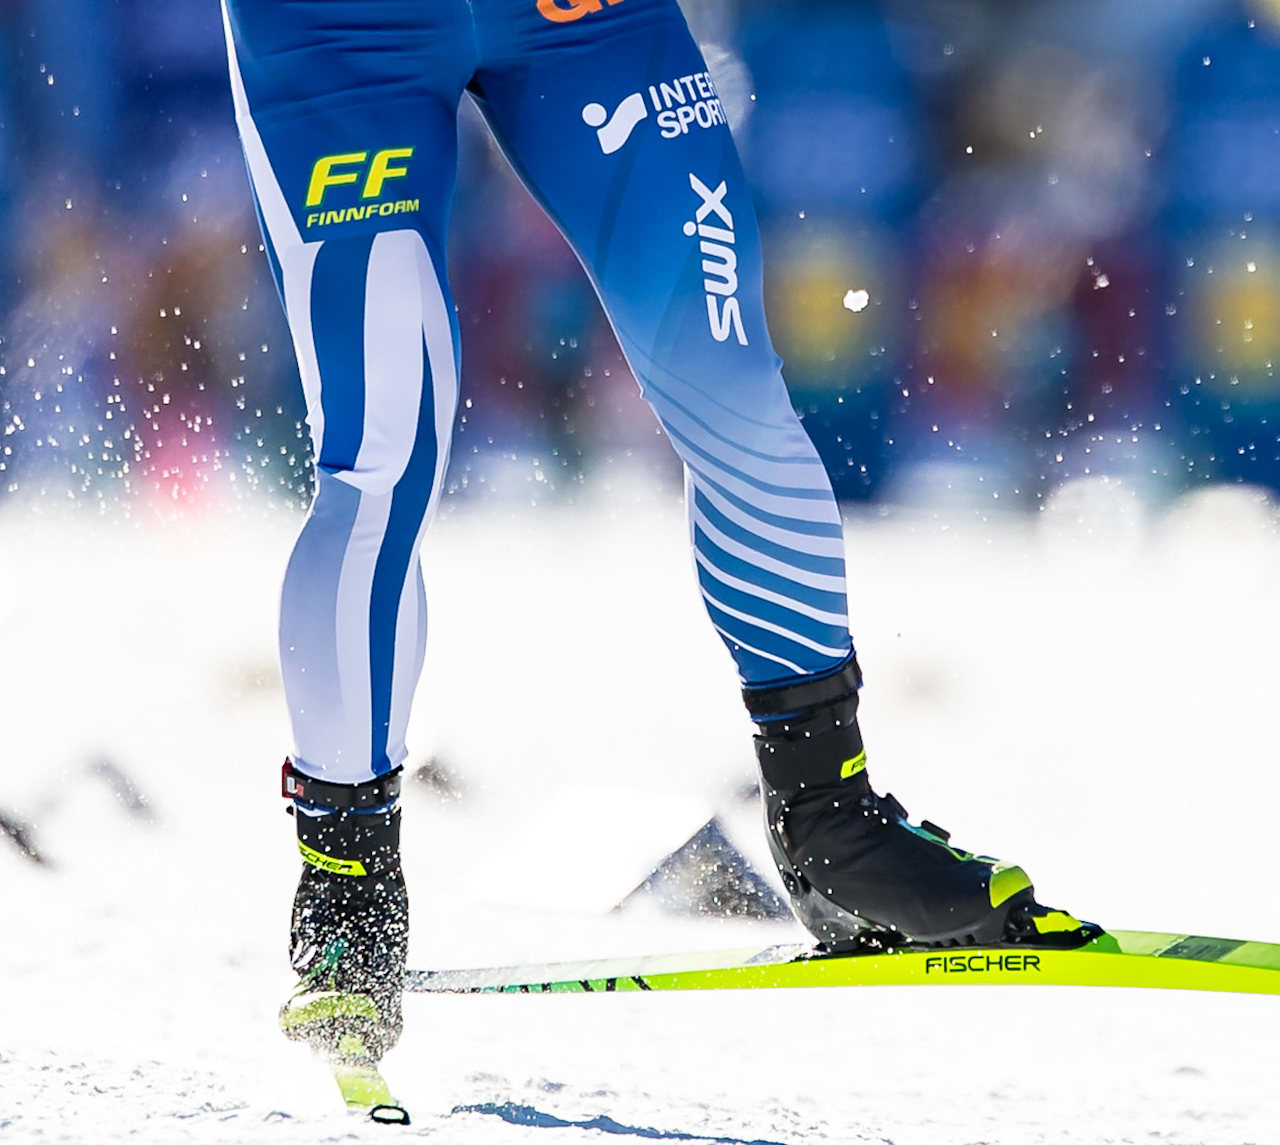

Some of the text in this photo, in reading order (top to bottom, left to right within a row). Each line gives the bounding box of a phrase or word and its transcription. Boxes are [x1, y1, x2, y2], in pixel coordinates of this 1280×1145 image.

[305, 146, 414, 207] FF
[306, 199, 419, 228] FINNFORM
[926, 955, 1041, 974] FISCHER
